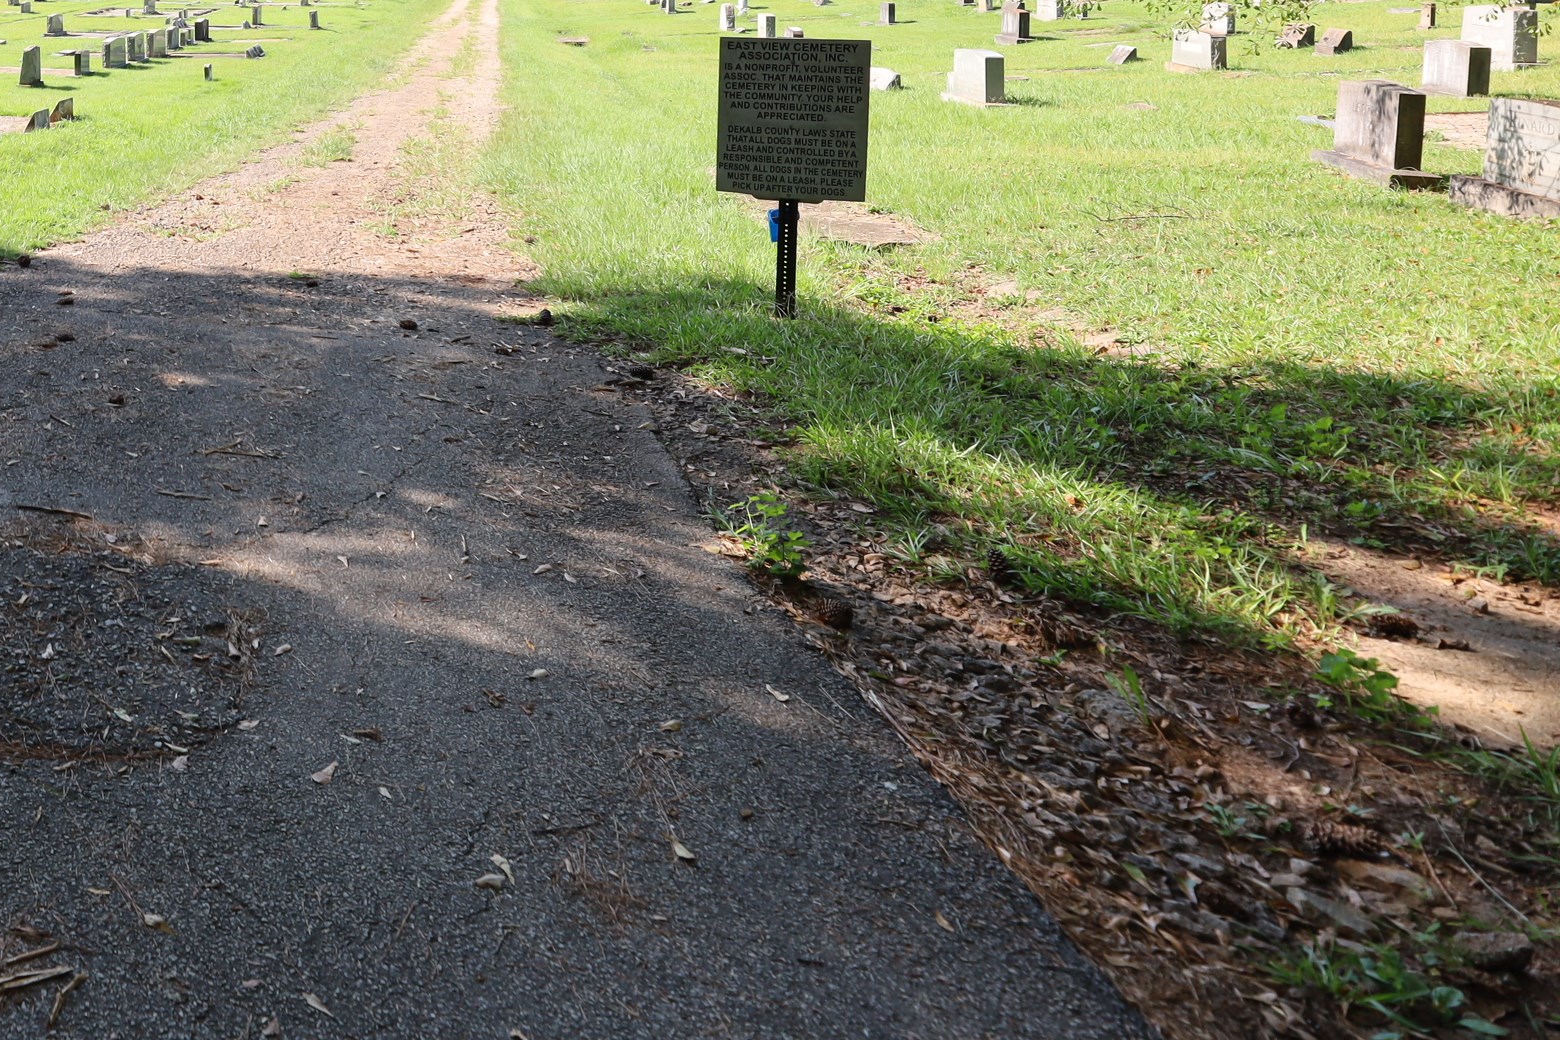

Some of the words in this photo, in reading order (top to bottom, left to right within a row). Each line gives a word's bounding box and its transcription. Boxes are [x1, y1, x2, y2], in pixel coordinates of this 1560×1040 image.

[728, 42, 757, 50] EAST
[762, 42, 789, 51] VIEW
[794, 43, 858, 53] CEMETERY
[739, 52, 820, 62] ASSOCIATION,
[825, 53, 848, 62] INC.
[745, 64, 801, 73] NONPROFIT,
[804, 66, 863, 74] VOLUNTEER
[789, 75, 840, 83] MAINTAINS
[725, 82, 775, 91] CEMETERY
[791, 84, 834, 93] KEEPING
[745, 92, 803, 101] COMMUNITY.
[807, 94, 833, 102] YOUR
[837, 96, 862, 104] HELP
[753, 102, 831, 112] CONTRIBUTIONS
[757, 112, 826, 122] APPRECIATED.
[728, 125, 762, 134] DEKALB
[765, 127, 800, 136] COUNTY
[776, 147, 835, 157] CONTROLLED
[724, 154, 782, 164] RESPONSIBLE
[806, 158, 858, 168] COMPETENT
[719, 162, 751, 171] PERSON.
[821, 168, 863, 178] CEMETERY
[788, 176, 817, 185] LEASH.
[733, 182, 751, 190] PICK
[766, 184, 791, 193] AFTER
[821, 188, 846, 196] DOGS.
